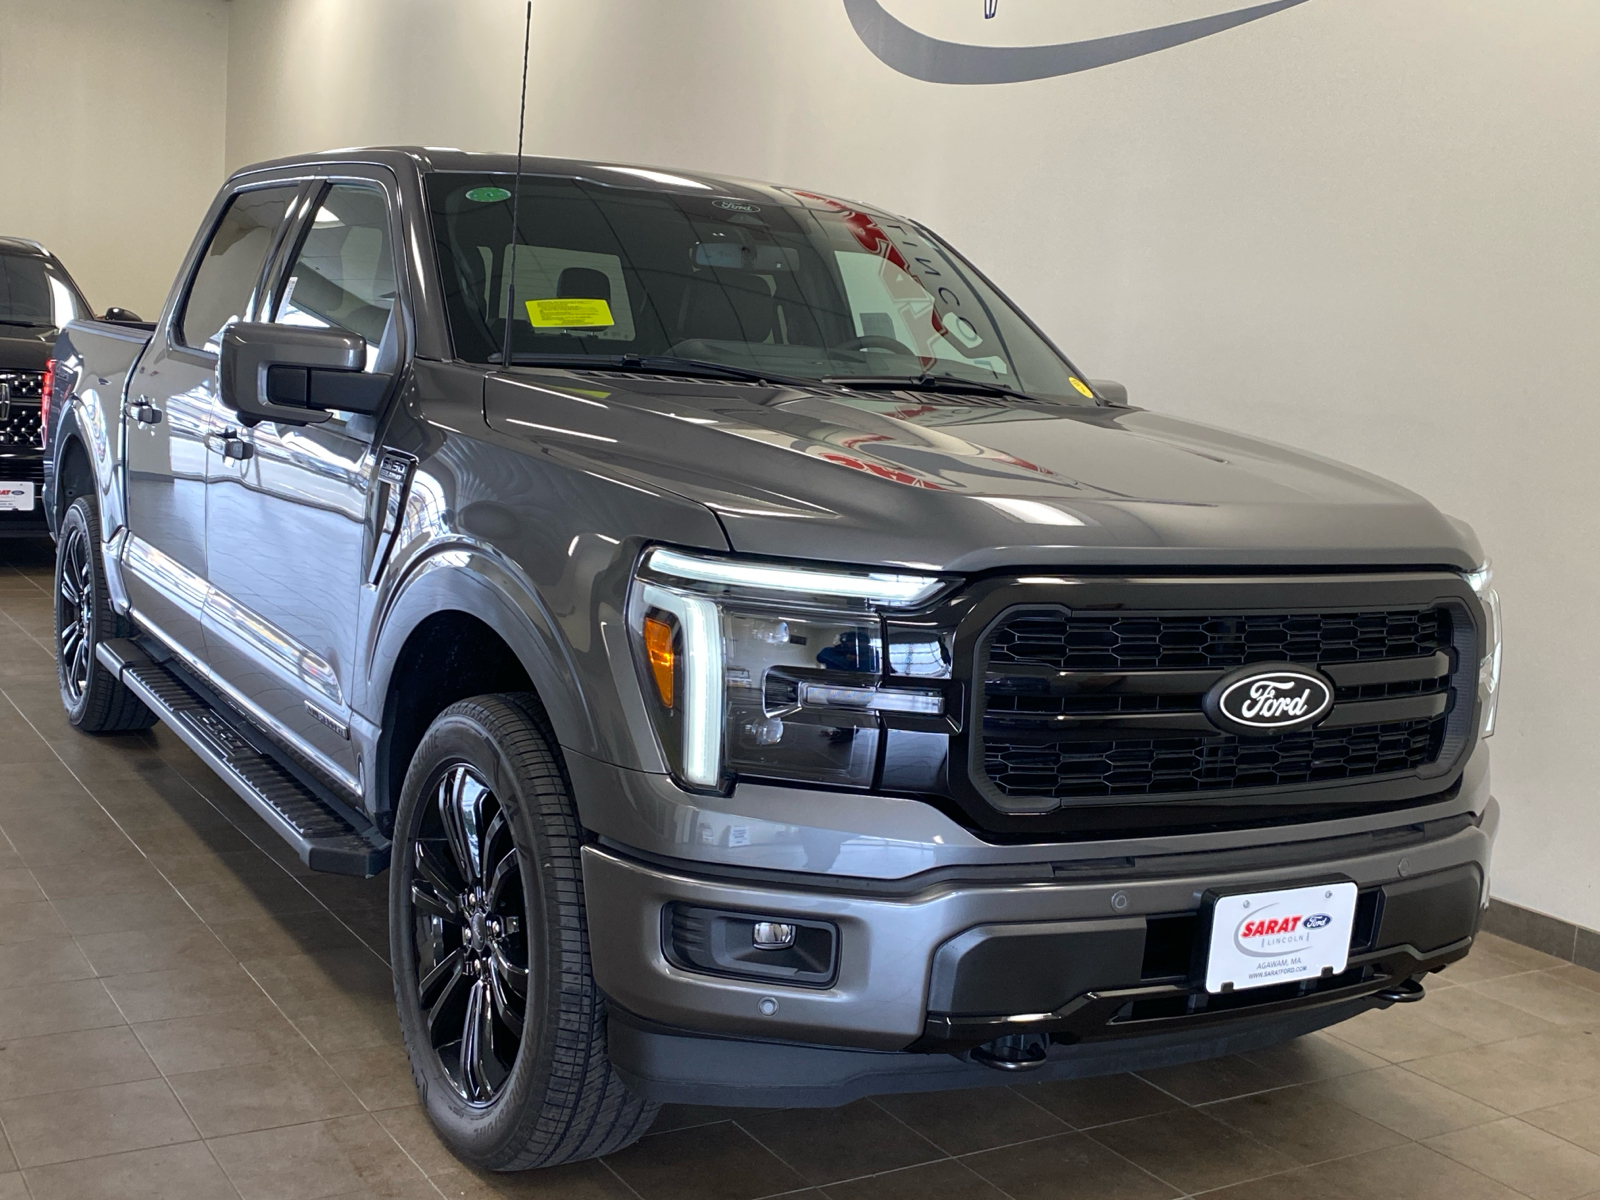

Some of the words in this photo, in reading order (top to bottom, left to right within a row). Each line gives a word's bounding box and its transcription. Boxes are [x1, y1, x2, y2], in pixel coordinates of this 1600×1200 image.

[721, 201, 753, 212] Ford
[1241, 680, 1311, 718] Ford
[1241, 915, 1303, 937] SARAT
[1306, 915, 1327, 928] Ford
[1267, 935, 1304, 946] LINCOLN
[1290, 957, 1302, 966] MA
